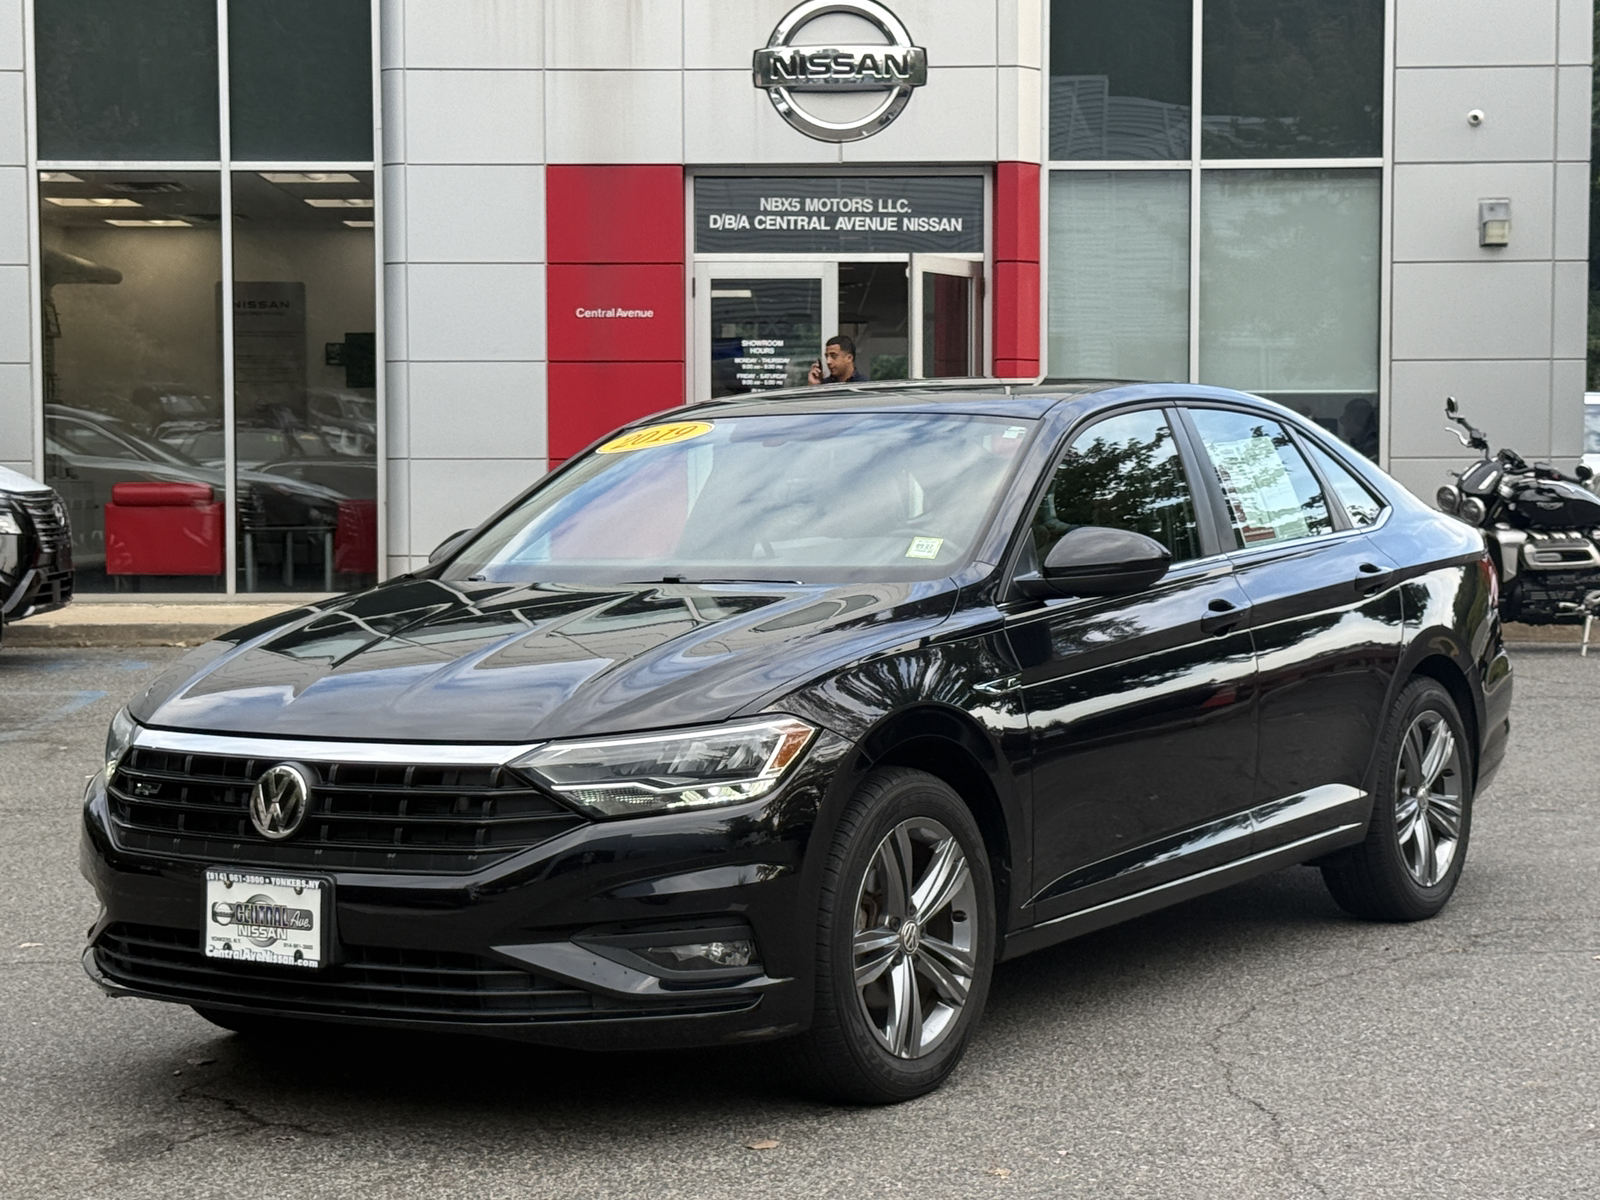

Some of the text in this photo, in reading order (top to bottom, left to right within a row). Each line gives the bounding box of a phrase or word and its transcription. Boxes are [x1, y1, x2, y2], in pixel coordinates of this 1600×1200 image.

[769, 53, 912, 79] NISSAN
[760, 197, 912, 213] NBX5 MOTORS LLC.
[709, 213, 963, 232] D/B/A CENTRAL AVENUE NISSAN
[575, 307, 654, 318] Central Avenue
[610, 425, 699, 451] 2019
[235, 901, 288, 927] CENTRAL
[238, 924, 288, 940] NISSAN
[205, 945, 319, 968] CentralAveNissan.com
